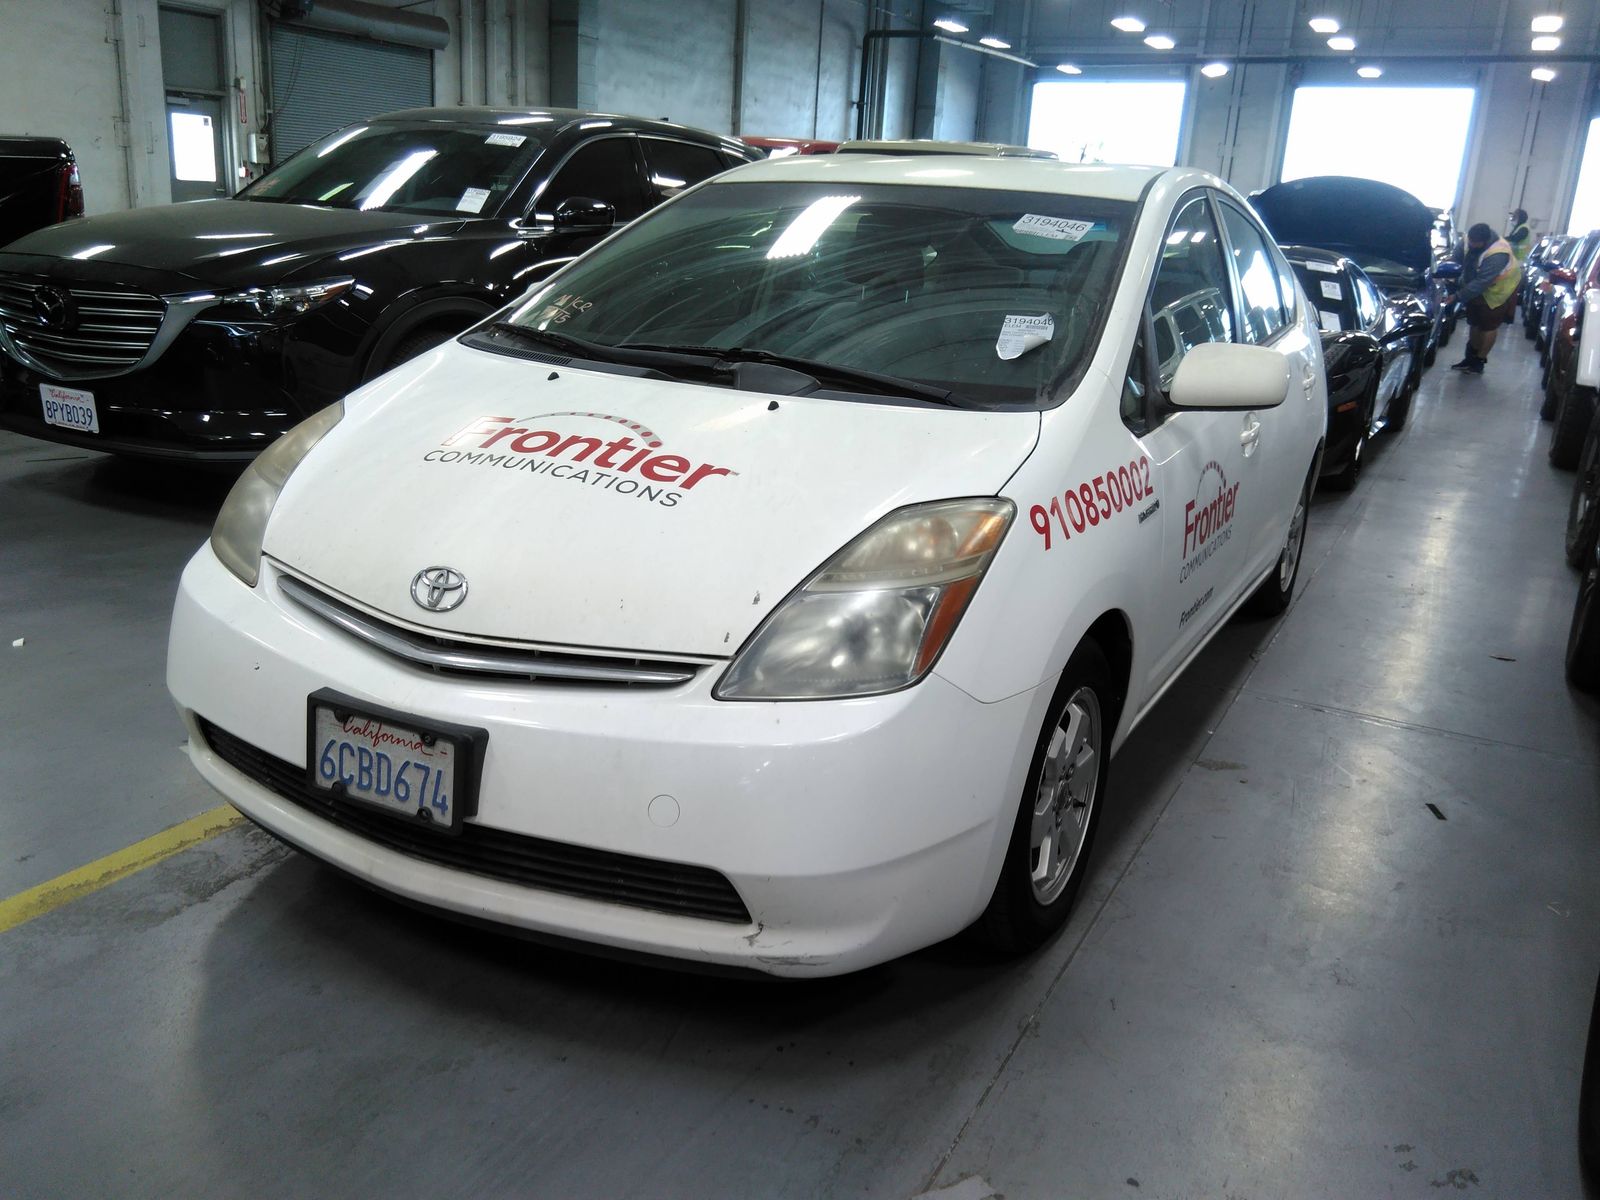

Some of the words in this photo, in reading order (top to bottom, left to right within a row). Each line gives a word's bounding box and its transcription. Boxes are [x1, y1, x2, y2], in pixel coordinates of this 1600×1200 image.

[1022, 215, 1088, 232] 3194046
[45, 400, 93, 427] 8PYB039
[423, 450, 683, 507] COMMUNICATIONS
[441, 416, 732, 490] Frontier
[1029, 455, 1154, 551] 910850002
[1183, 481, 1240, 560] Frontier
[342, 715, 434, 757] California
[320, 739, 448, 818] 6CBD674
